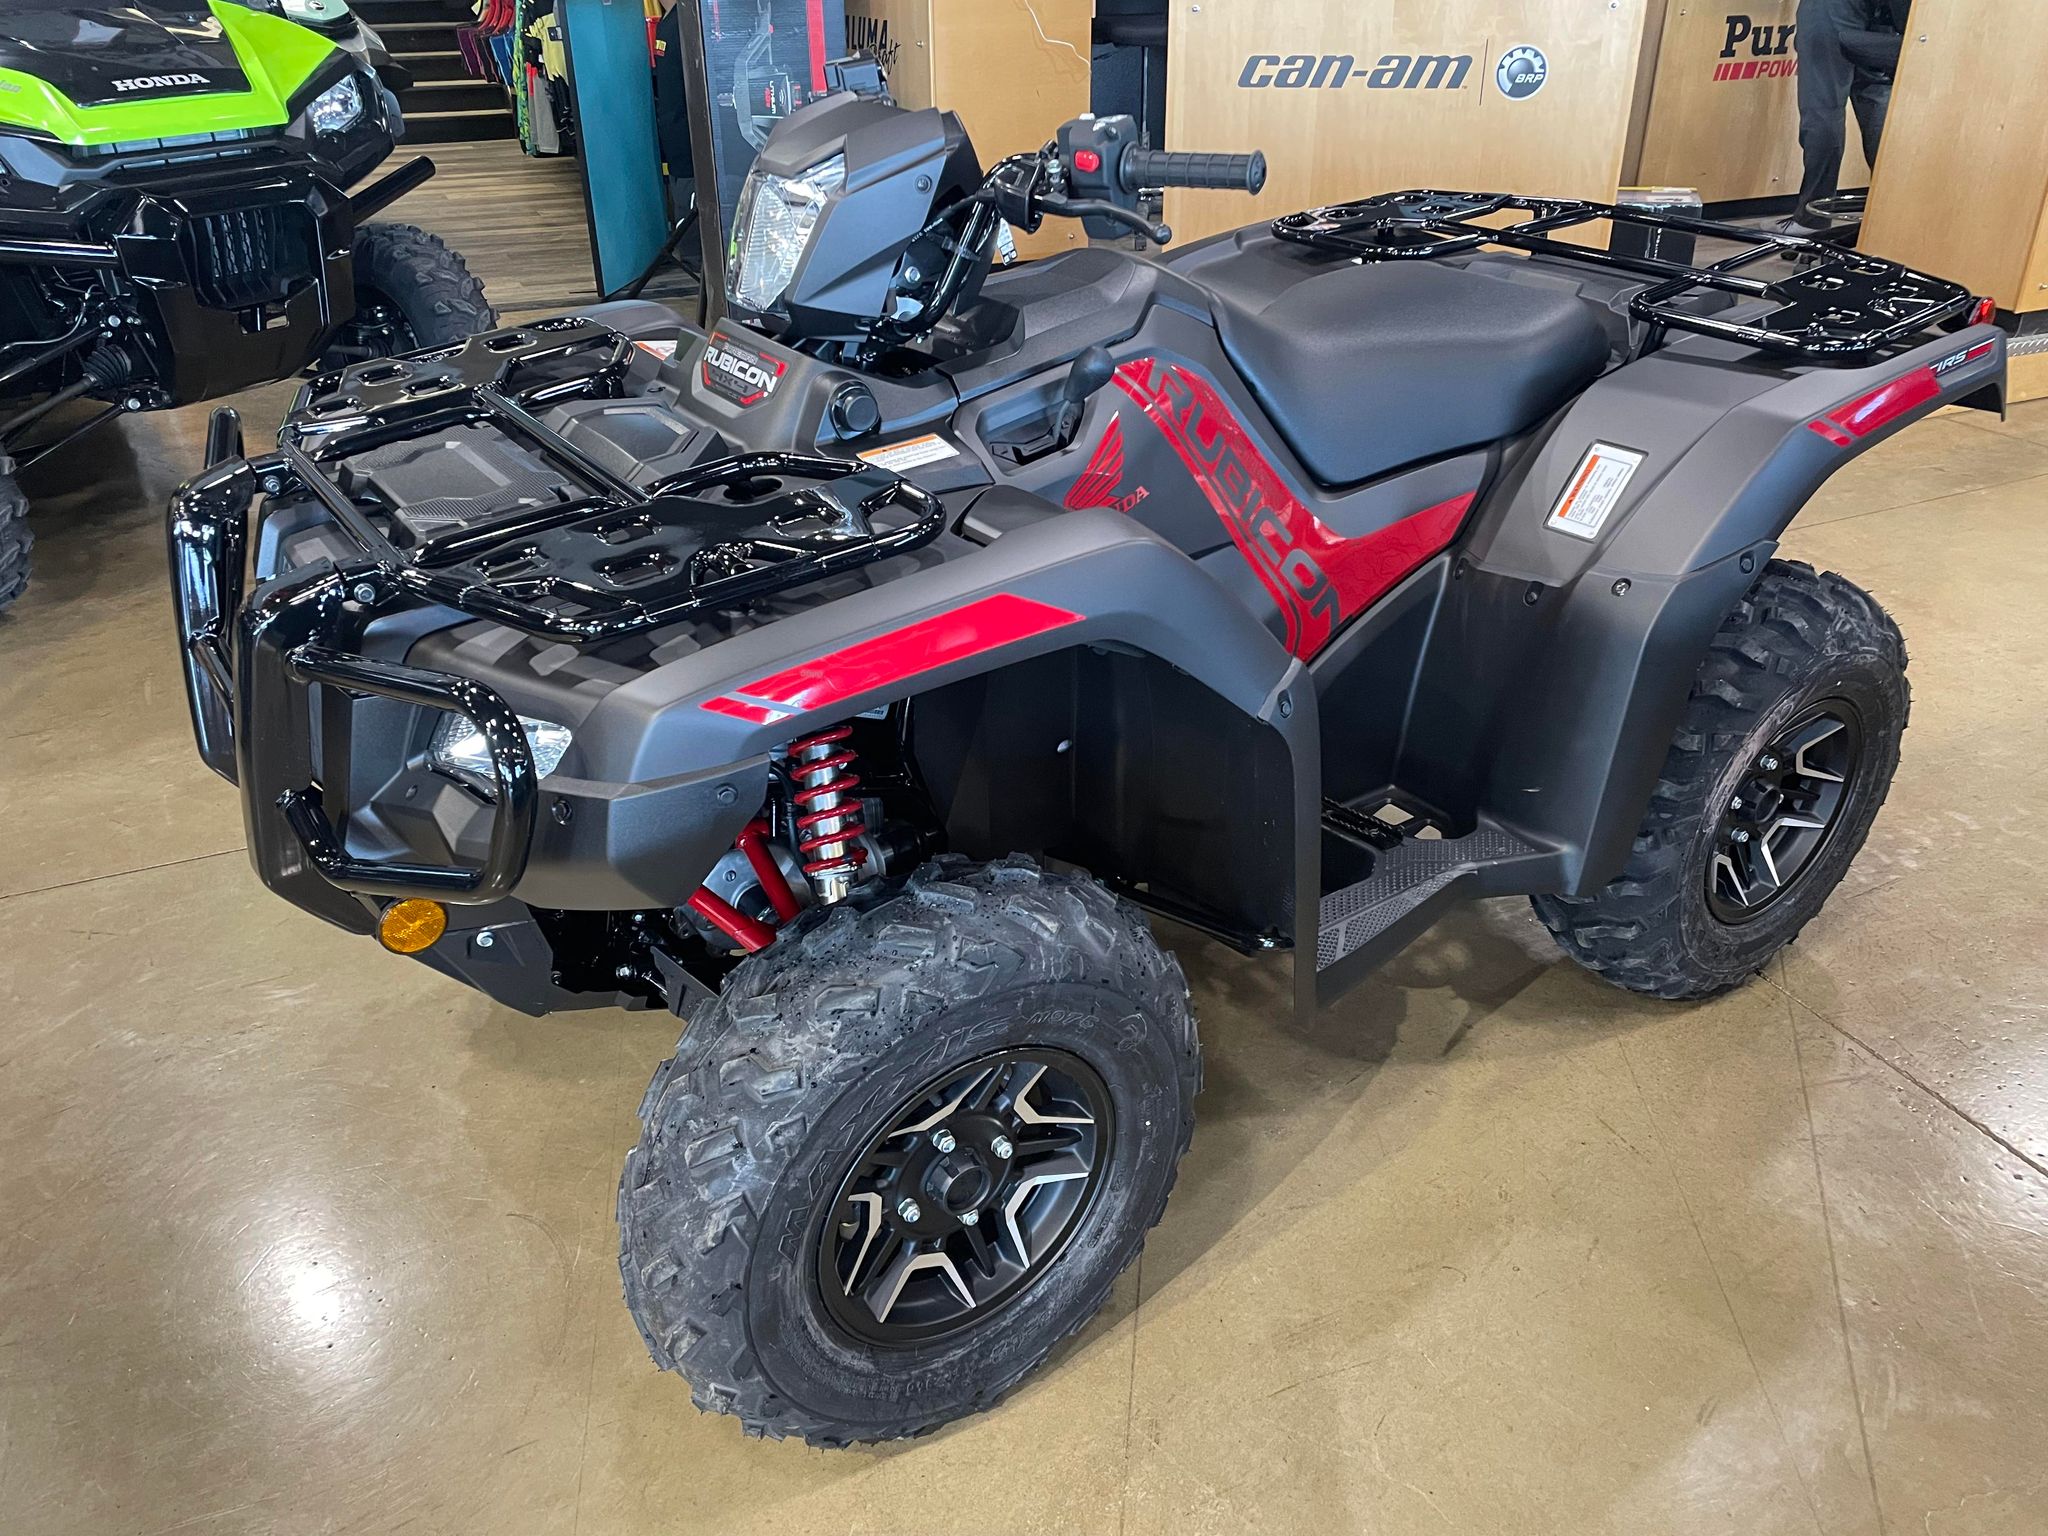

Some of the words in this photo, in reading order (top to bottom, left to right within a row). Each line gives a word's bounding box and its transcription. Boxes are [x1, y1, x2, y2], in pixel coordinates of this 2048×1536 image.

[1720, 15, 1798, 58] Pur
[111, 73, 211, 92] HONDA
[1237, 55, 1473, 89] can-am
[1514, 73, 1545, 84] BRP
[1756, 60, 1798, 79] POW
[703, 345, 778, 393] RUBICON
